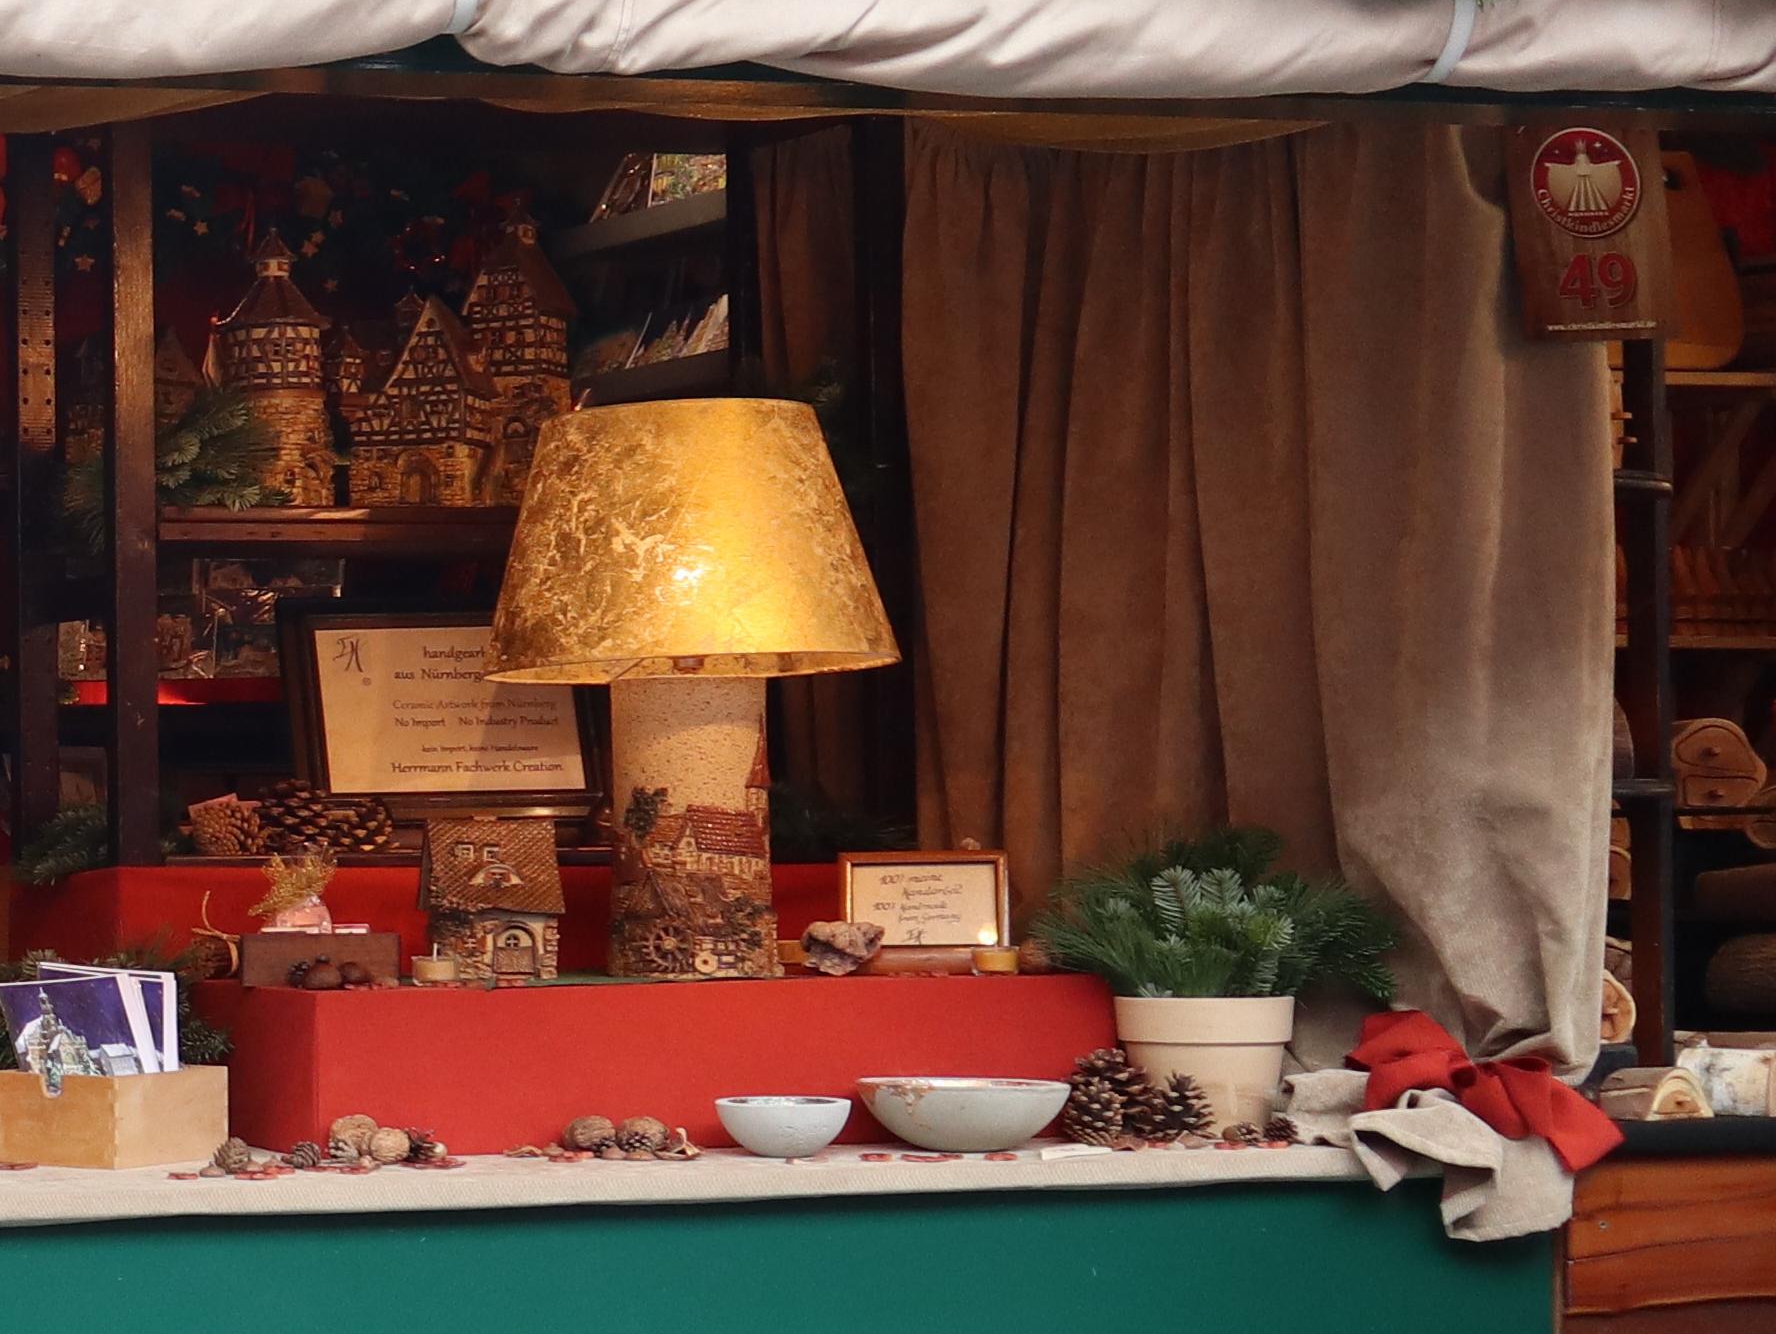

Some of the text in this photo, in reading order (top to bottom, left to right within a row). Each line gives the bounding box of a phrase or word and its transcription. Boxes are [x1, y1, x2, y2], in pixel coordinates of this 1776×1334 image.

[1537, 186, 1635, 233] Christkindlesmarkt
[1559, 250, 1638, 308] 49
[393, 670, 416, 680] aus
[479, 698, 507, 712] from
[394, 717, 410, 727] No
[411, 717, 446, 730] Import
[458, 717, 474, 727] No
[475, 716, 518, 729] Industry
[391, 761, 564, 774] Herrmann Fachwerk Creation
